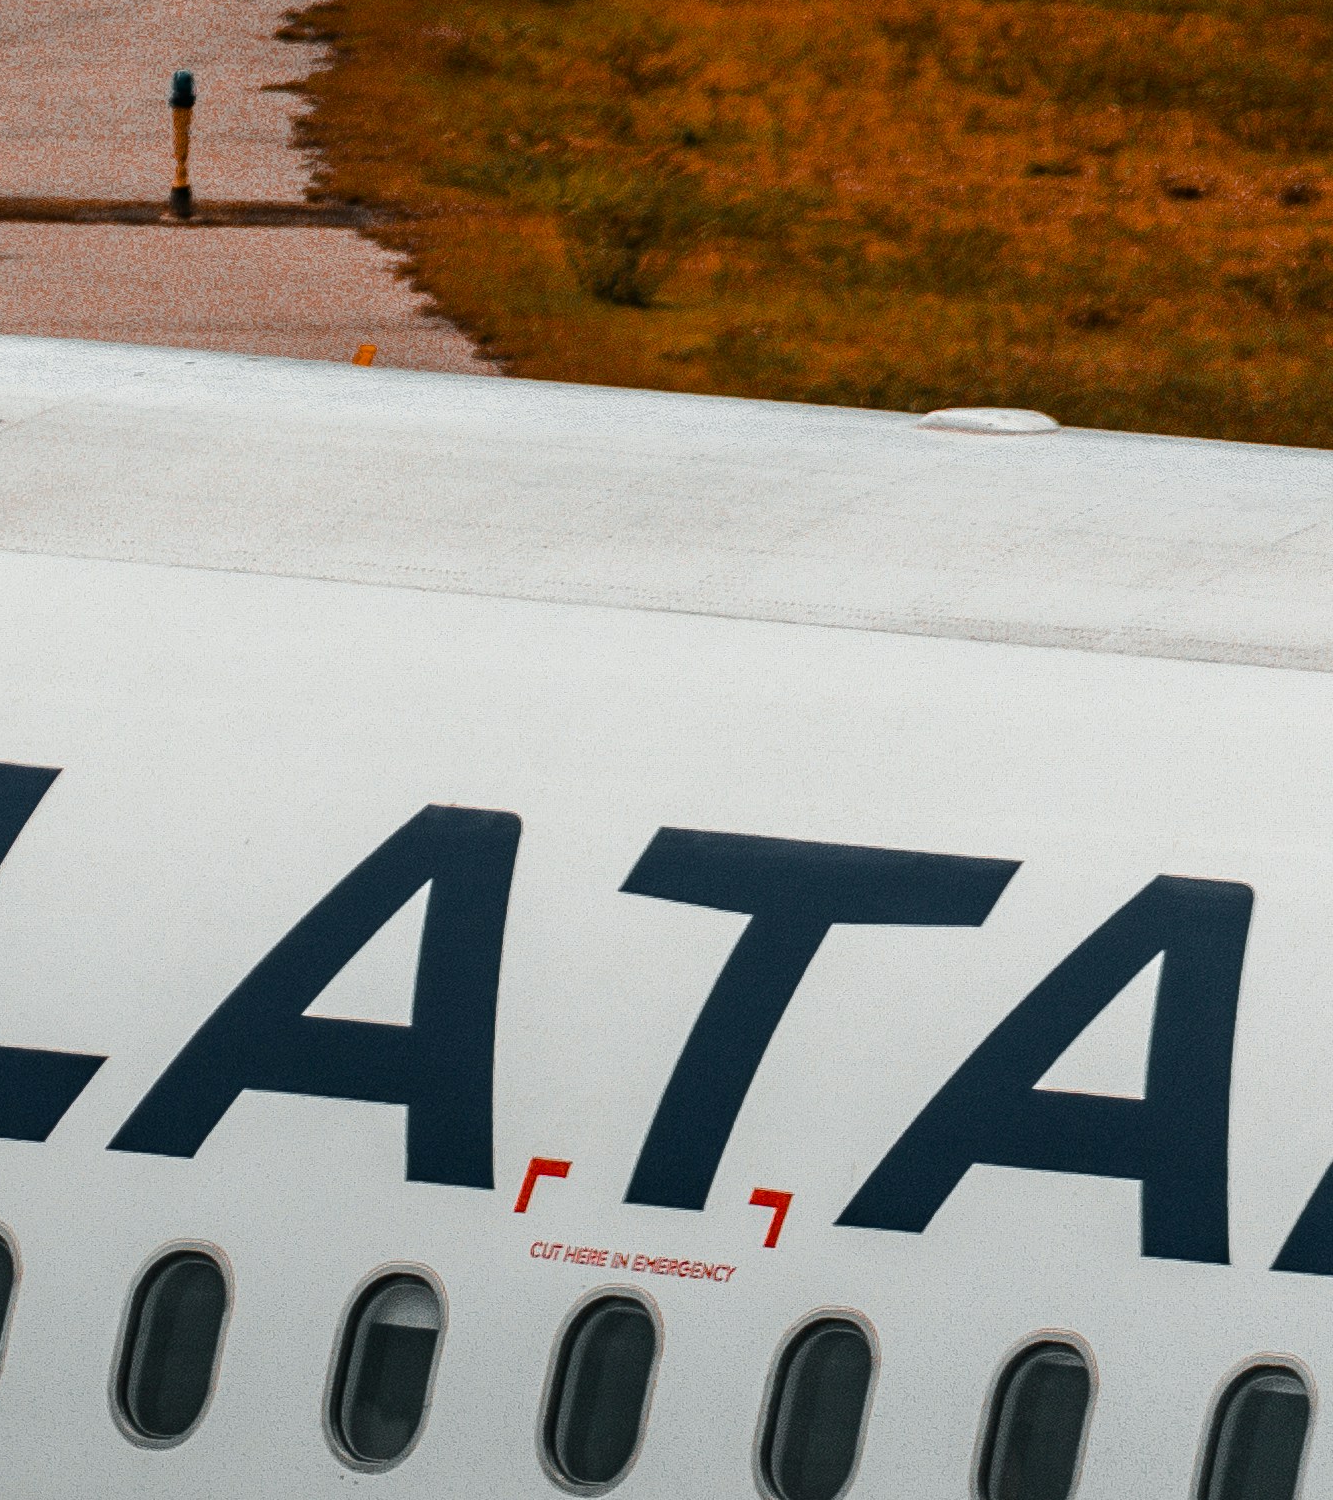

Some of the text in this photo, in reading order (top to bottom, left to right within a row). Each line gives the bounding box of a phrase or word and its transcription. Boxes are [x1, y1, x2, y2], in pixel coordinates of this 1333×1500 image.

[529, 1240, 738, 1283] CUT HERE IN EMERGENCY
